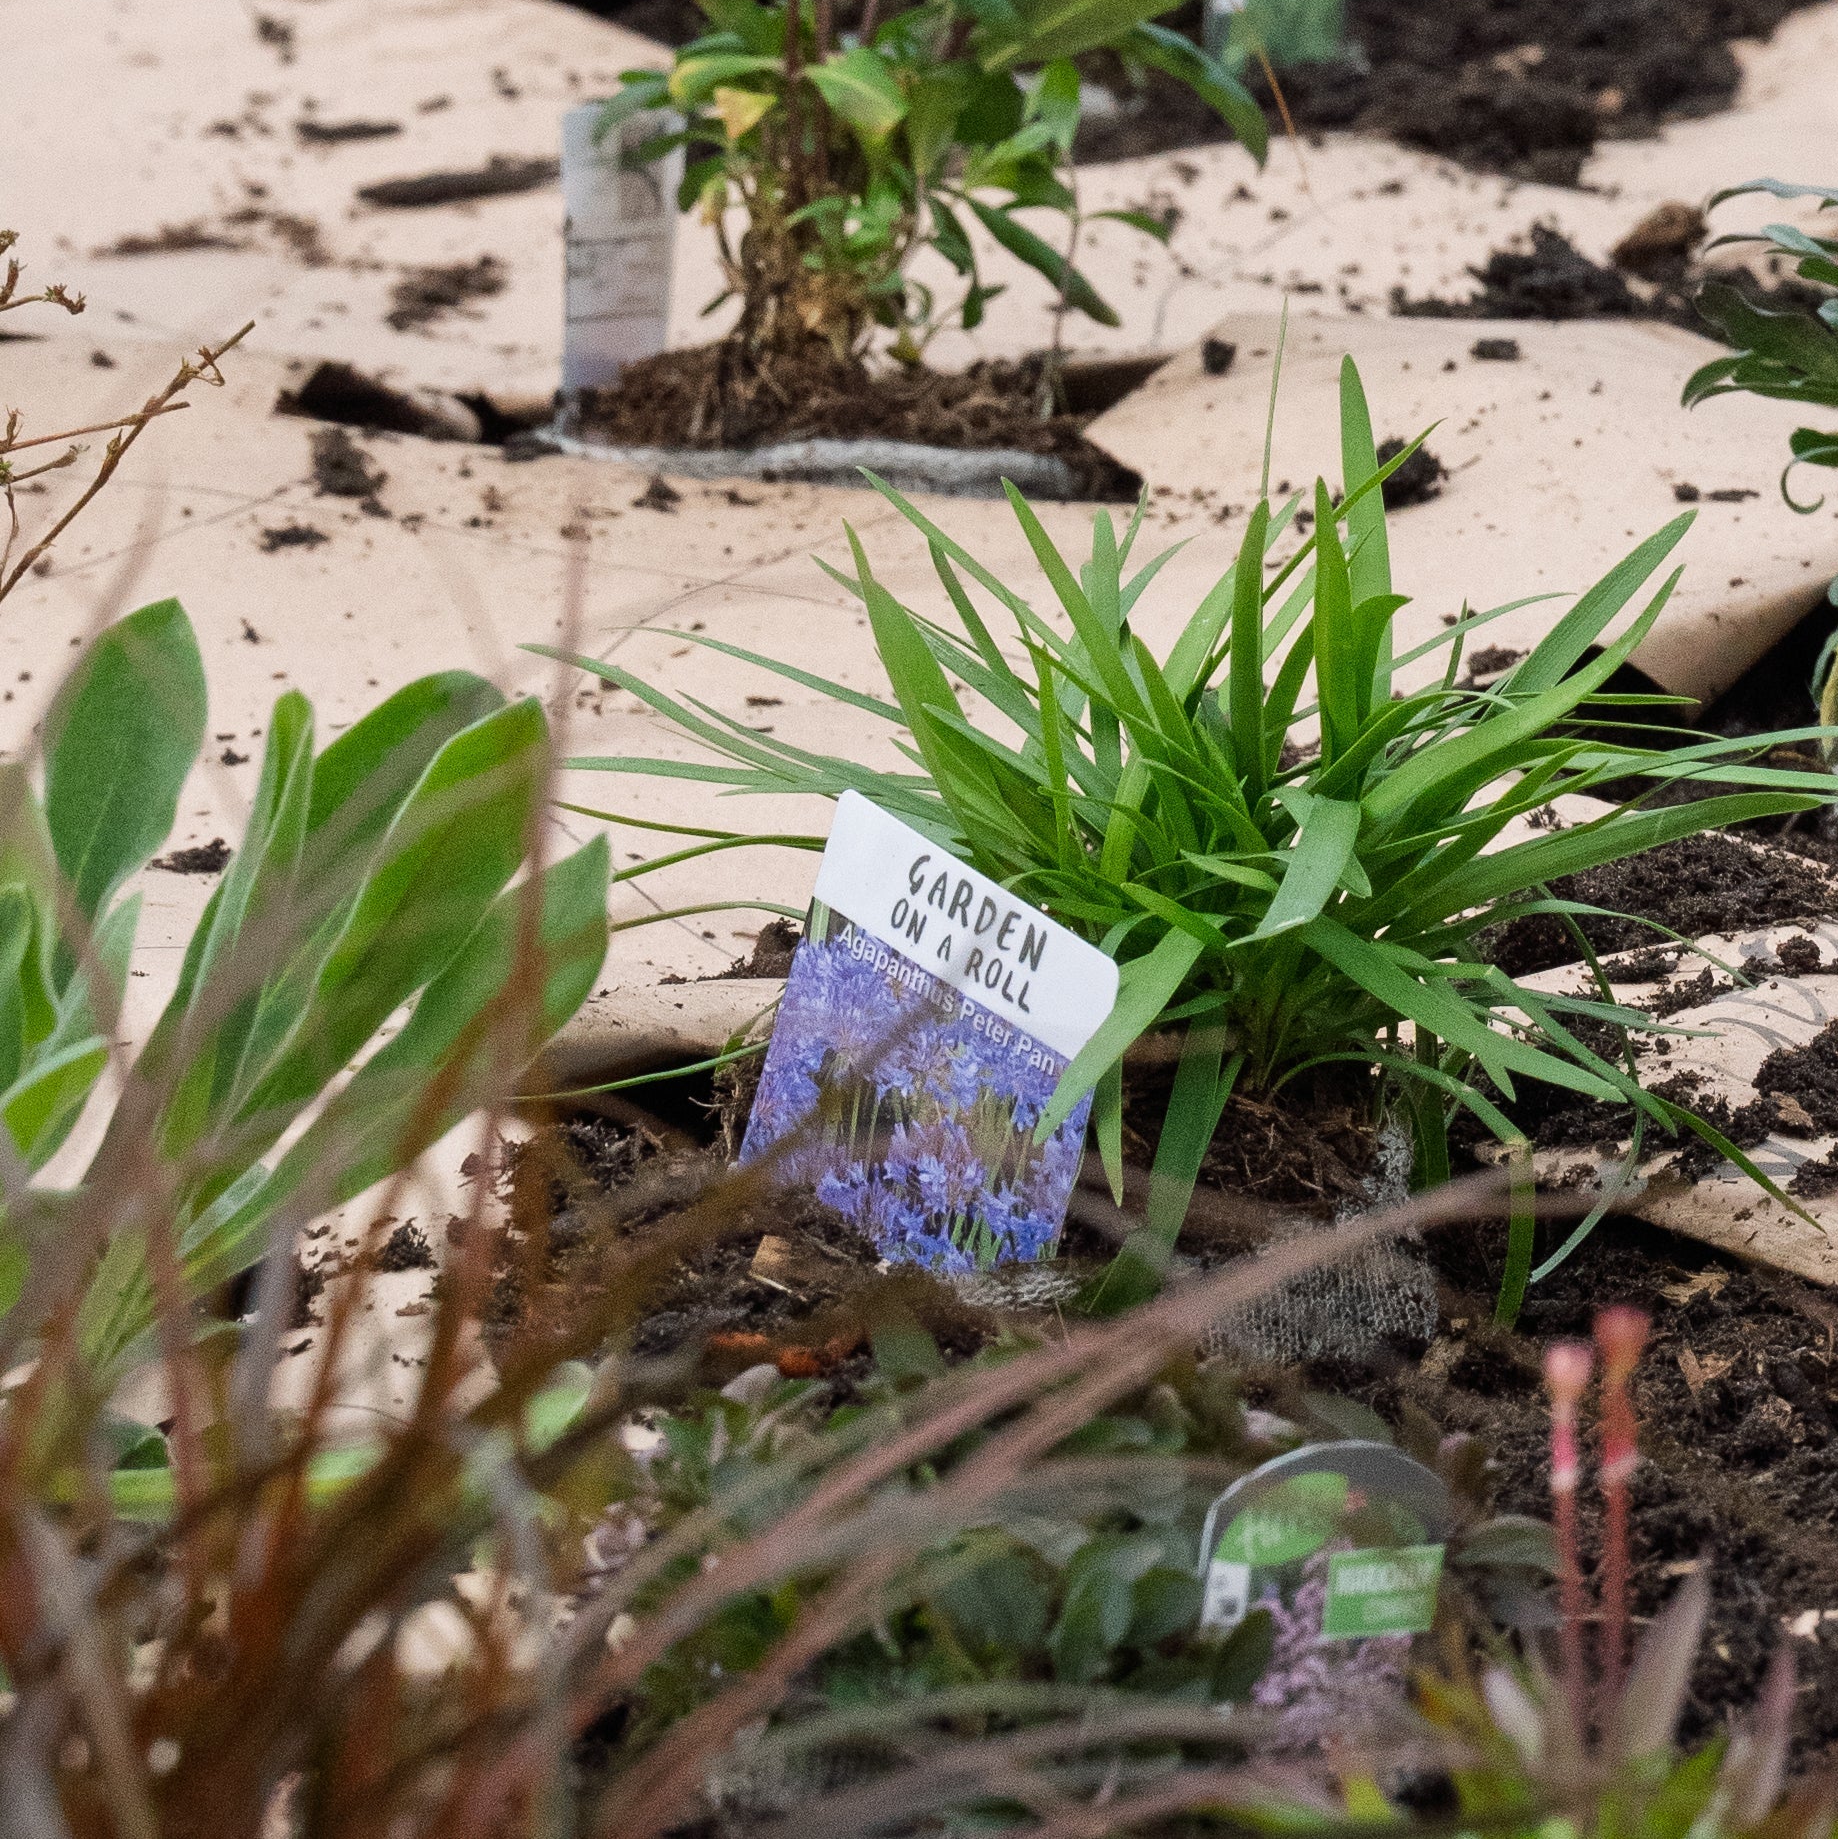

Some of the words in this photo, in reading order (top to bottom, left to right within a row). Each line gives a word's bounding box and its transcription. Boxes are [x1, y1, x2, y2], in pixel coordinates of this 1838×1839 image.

[891, 898, 927, 944] ON
[936, 933, 952, 962] A
[963, 947, 1030, 1014] ROLL
[908, 854, 1047, 972] GARDEN
[838, 923, 955, 1013] Agapanthus
[960, 998, 1014, 1048] Peter
[1016, 1037, 1055, 1075] Pan
